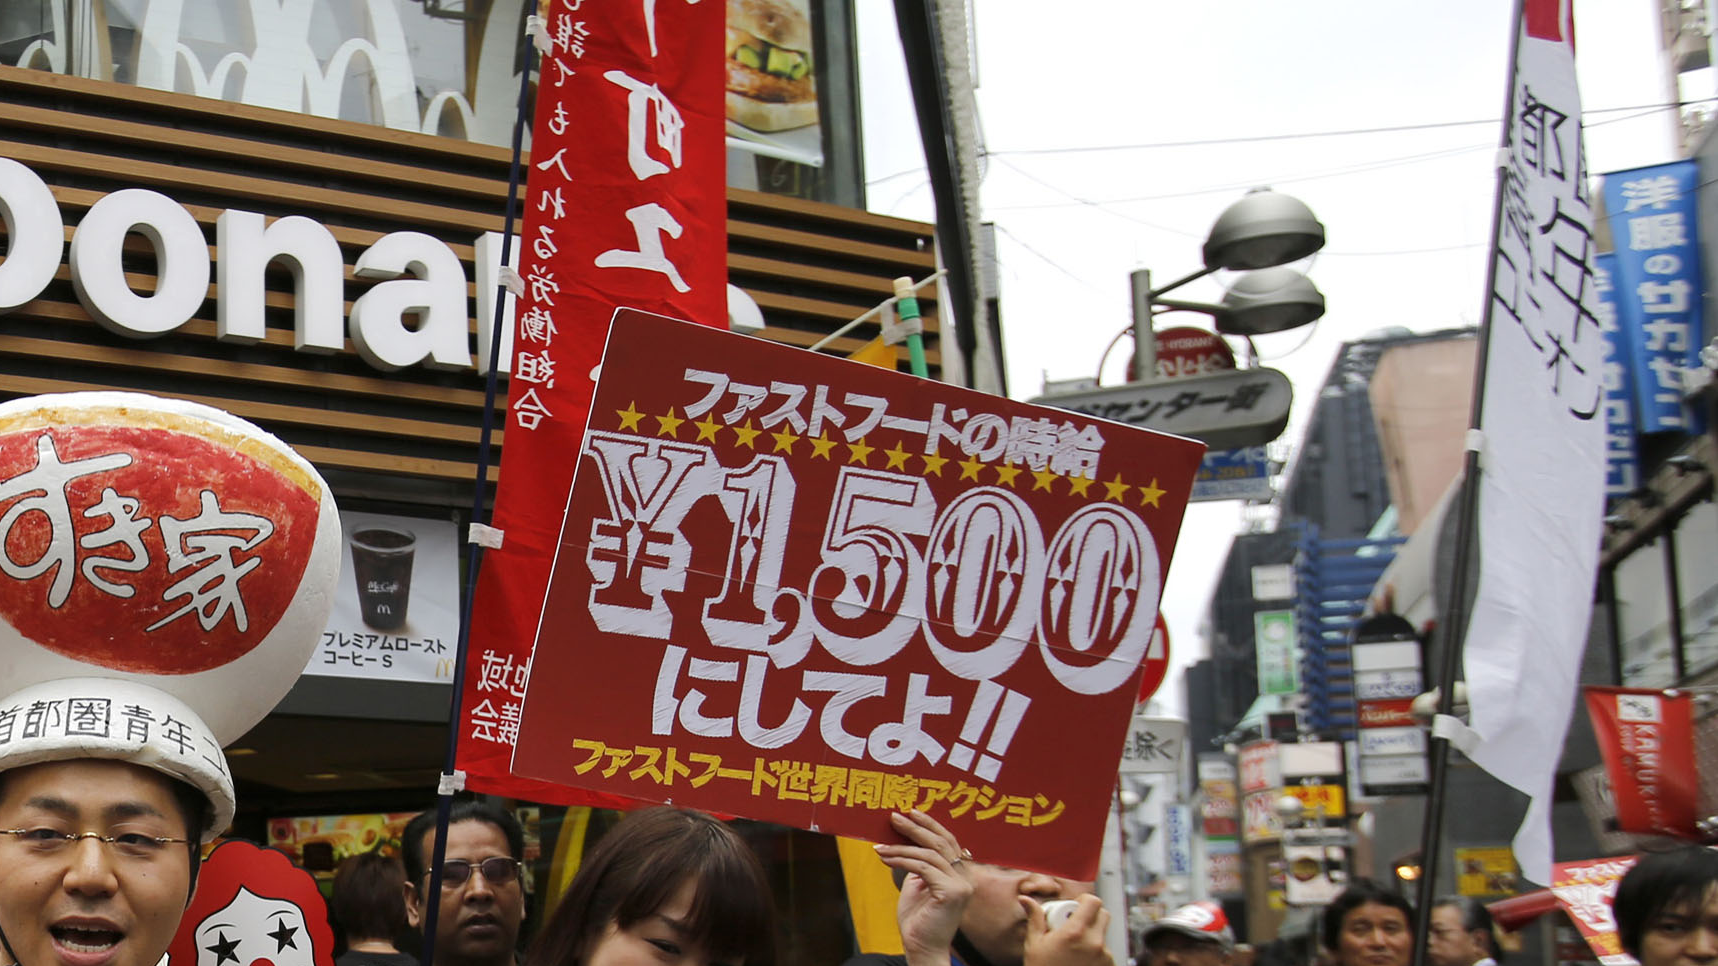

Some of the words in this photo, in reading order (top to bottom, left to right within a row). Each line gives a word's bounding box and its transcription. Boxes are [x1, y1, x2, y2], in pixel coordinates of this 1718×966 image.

[683, 369, 1106, 480] ファストフードの時給
[584, 430, 1161, 695] ¥1,500
[323, 632, 446, 654] プレミアムロースト
[324, 650, 377, 666] コーヒー
[382, 654, 393, 668] S
[651, 644, 1033, 783] にしてよ!!
[571, 738, 1066, 828] ファストフード世界同時アクション
